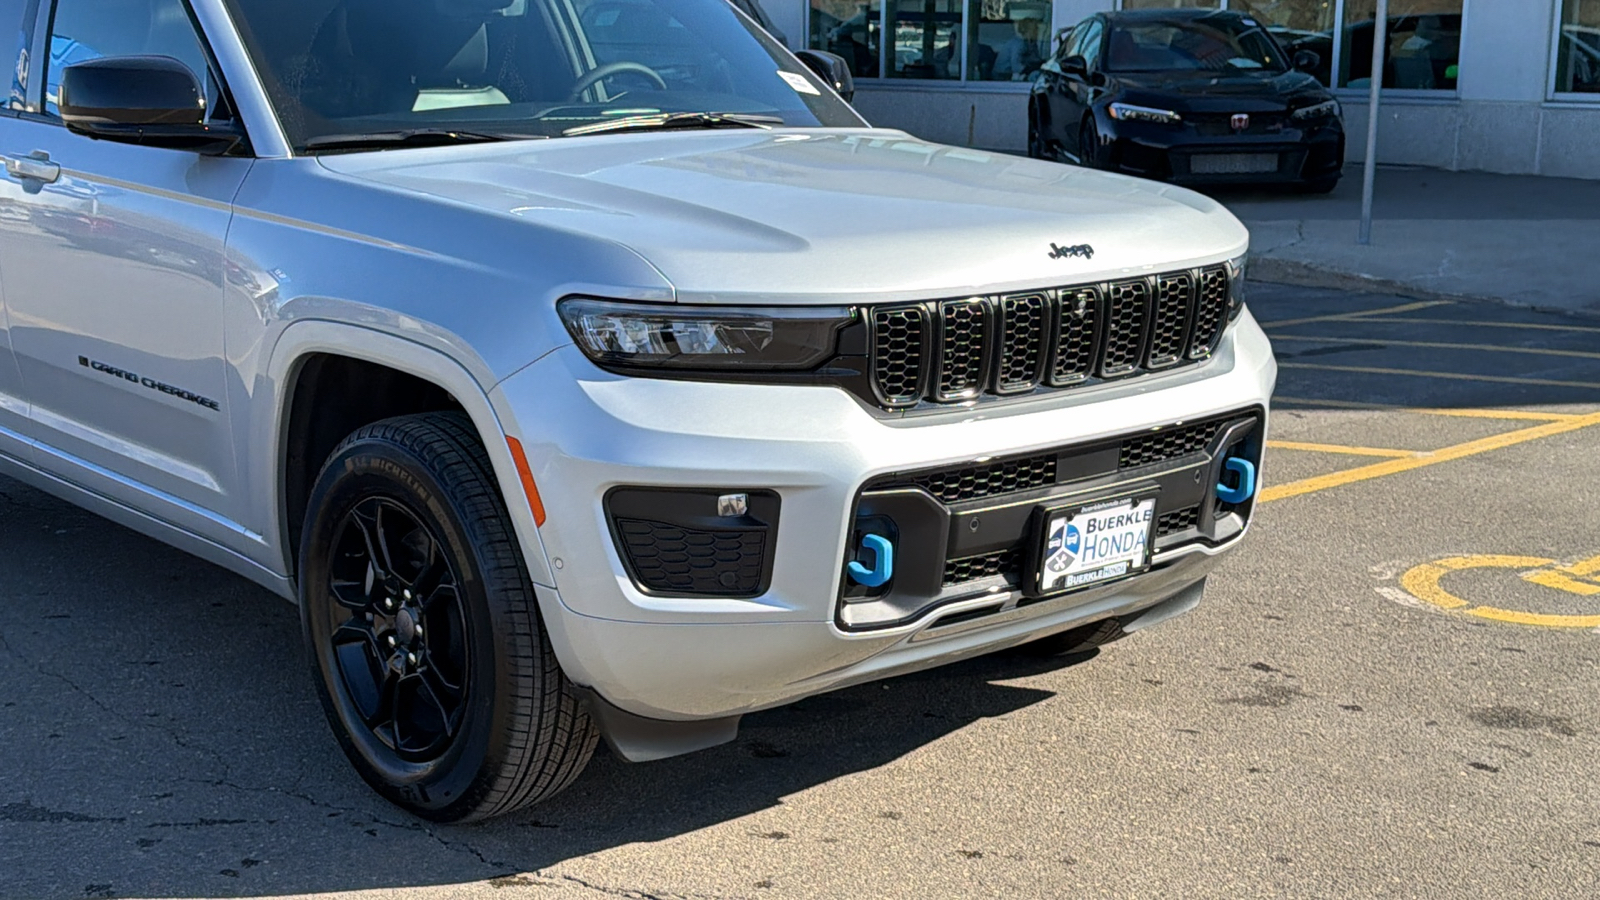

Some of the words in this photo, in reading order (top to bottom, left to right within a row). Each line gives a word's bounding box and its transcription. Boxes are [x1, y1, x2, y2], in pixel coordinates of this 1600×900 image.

[1047, 242, 1094, 260] Jeep
[90, 360, 139, 383] GRAND
[141, 377, 220, 412] CHEROKEE
[370, 458, 428, 500] MICHELIN
[1086, 509, 1152, 534] BUERKLE
[1081, 529, 1146, 562] HONDA
